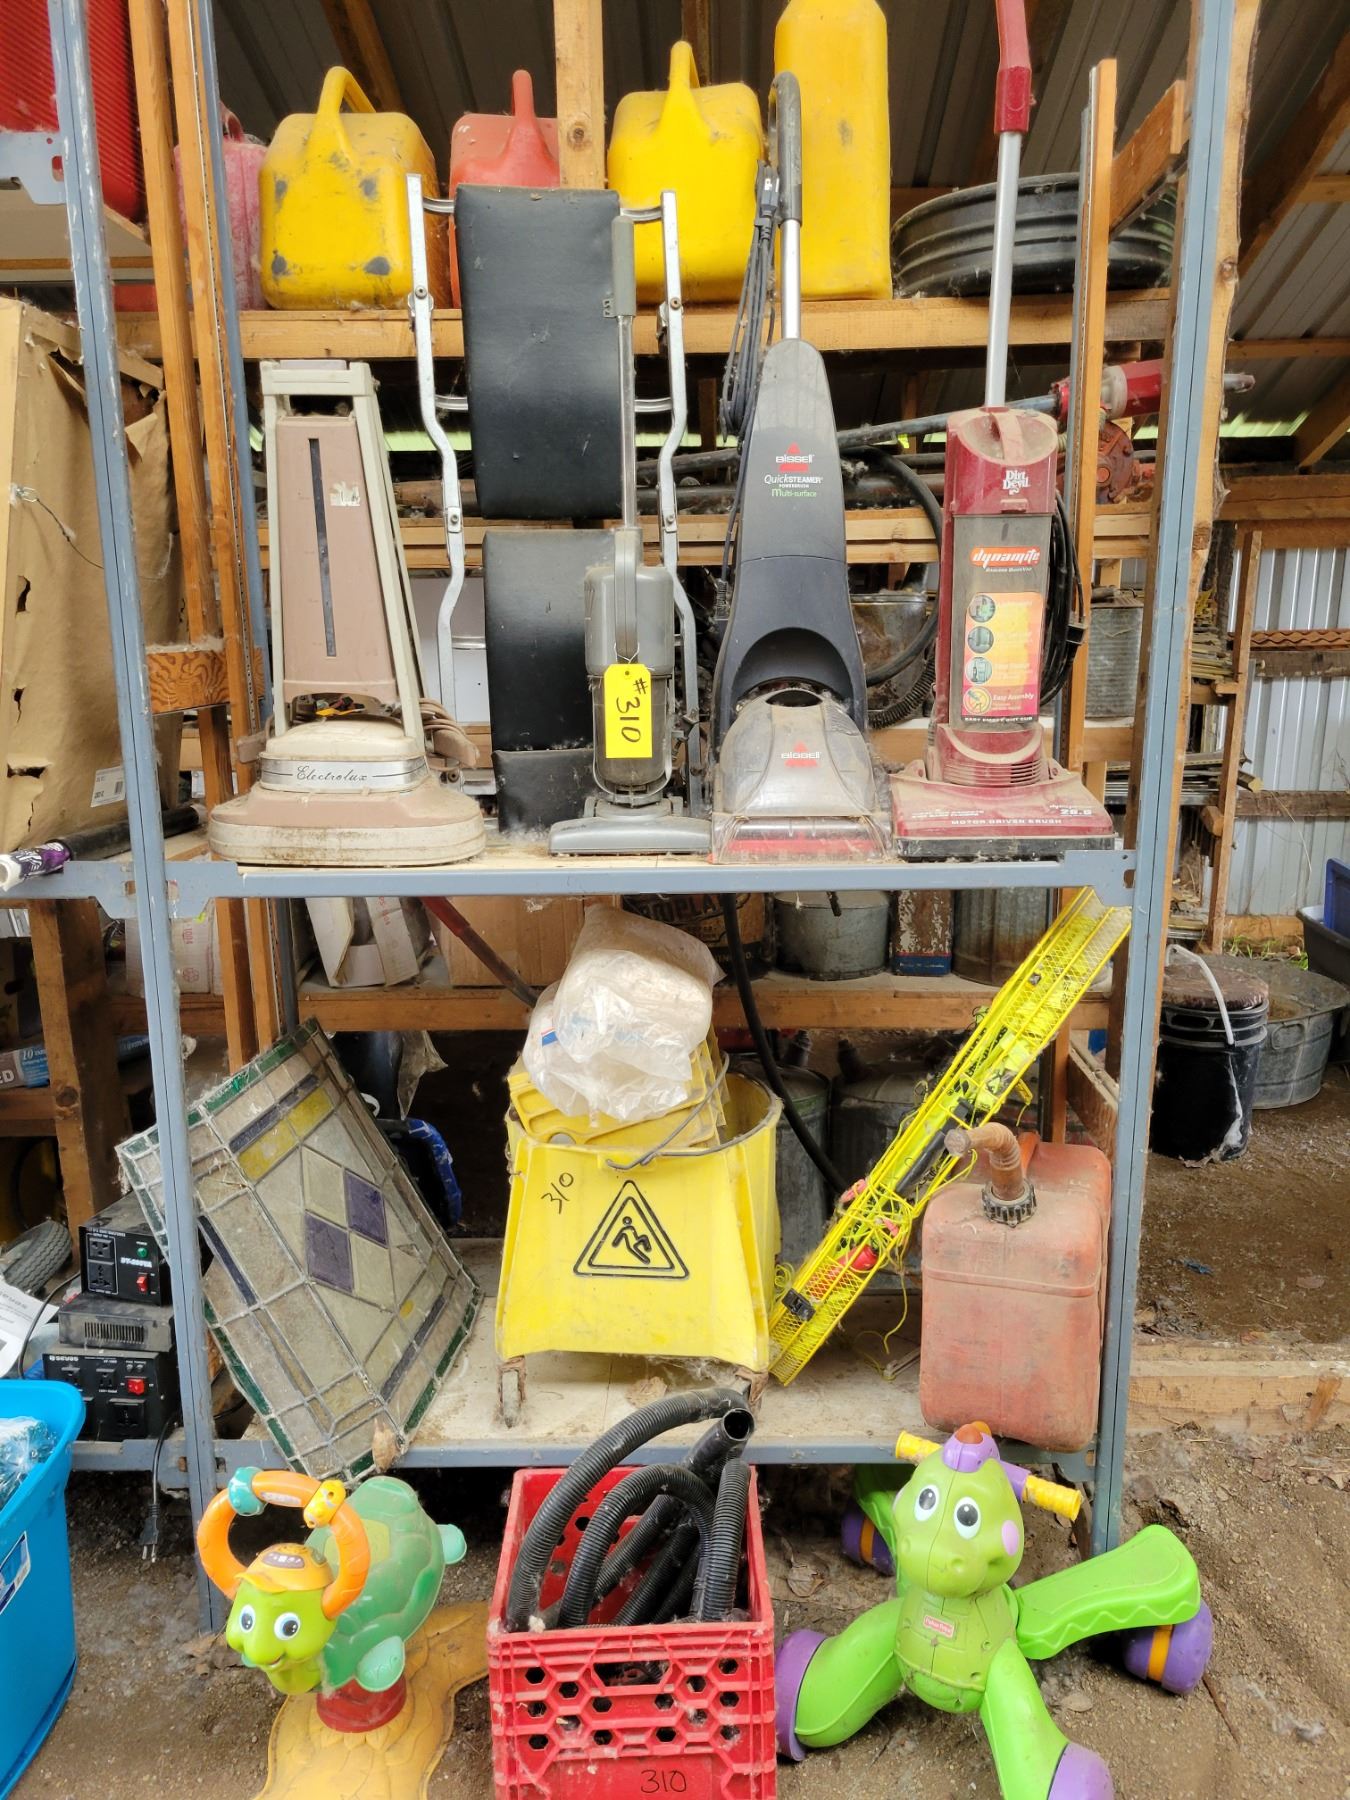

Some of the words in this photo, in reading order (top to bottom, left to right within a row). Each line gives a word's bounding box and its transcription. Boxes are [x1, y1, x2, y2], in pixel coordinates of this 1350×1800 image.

[1005, 470, 1027, 481] Dirt
[1003, 477, 1031, 494] Devil
[972, 549, 1040, 568] dynamite
[296, 765, 368, 781] Electrolux
[640, 1769, 687, 1793] 310
